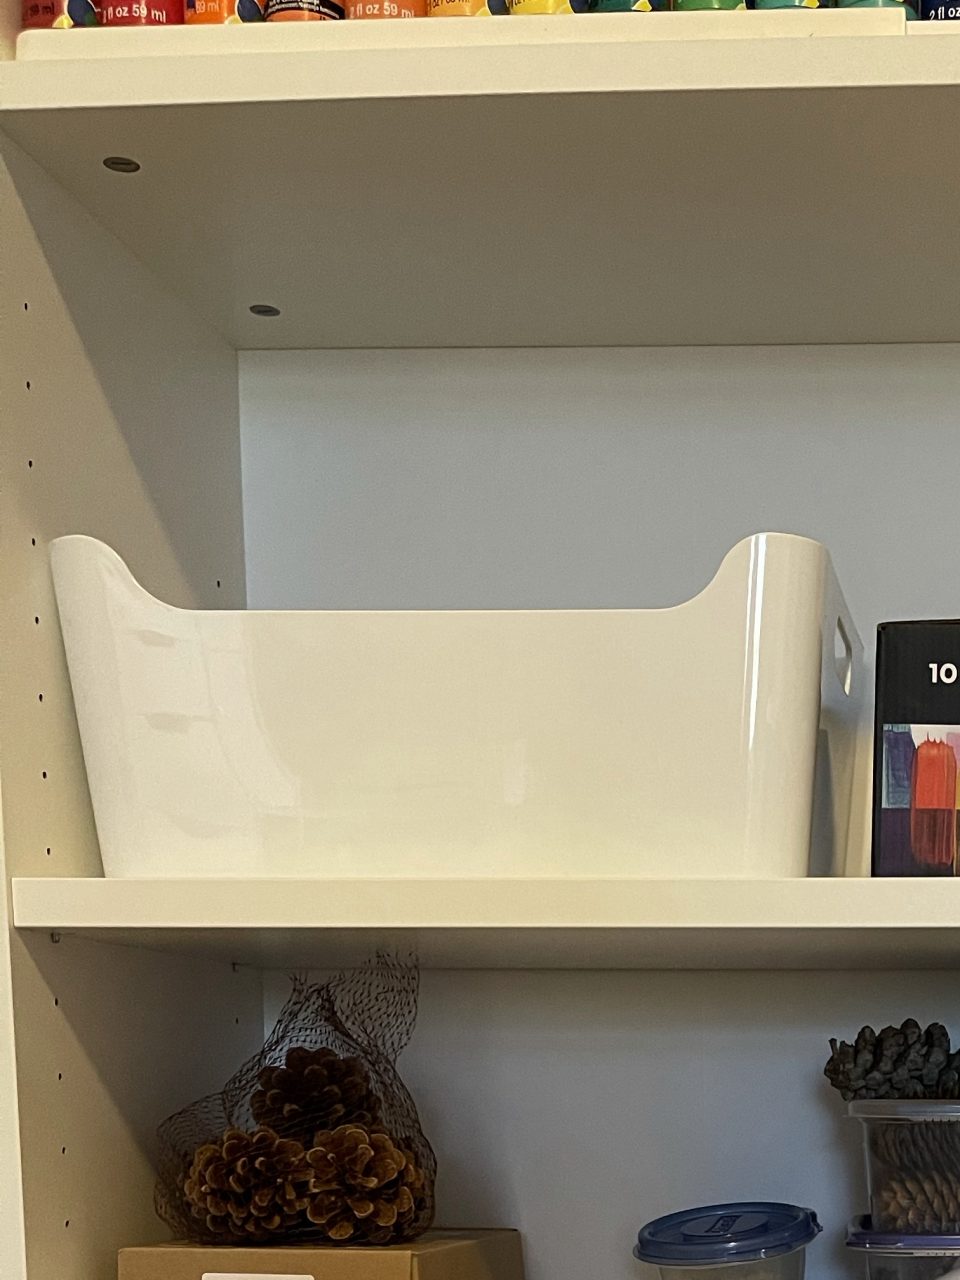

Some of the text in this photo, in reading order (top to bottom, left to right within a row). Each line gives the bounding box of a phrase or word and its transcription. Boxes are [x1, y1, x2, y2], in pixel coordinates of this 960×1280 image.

[115, 8, 129, 18] oz
[132, 4, 148, 17] 59
[151, 9, 167, 23] ml
[365, 4, 380, 14] oz
[383, 3, 398, 15] 59
[401, 8, 415, 18] ml
[929, 10, 936, 21] 2
[938, 7, 945, 19] fl
[928, 663, 958, 684] 10
